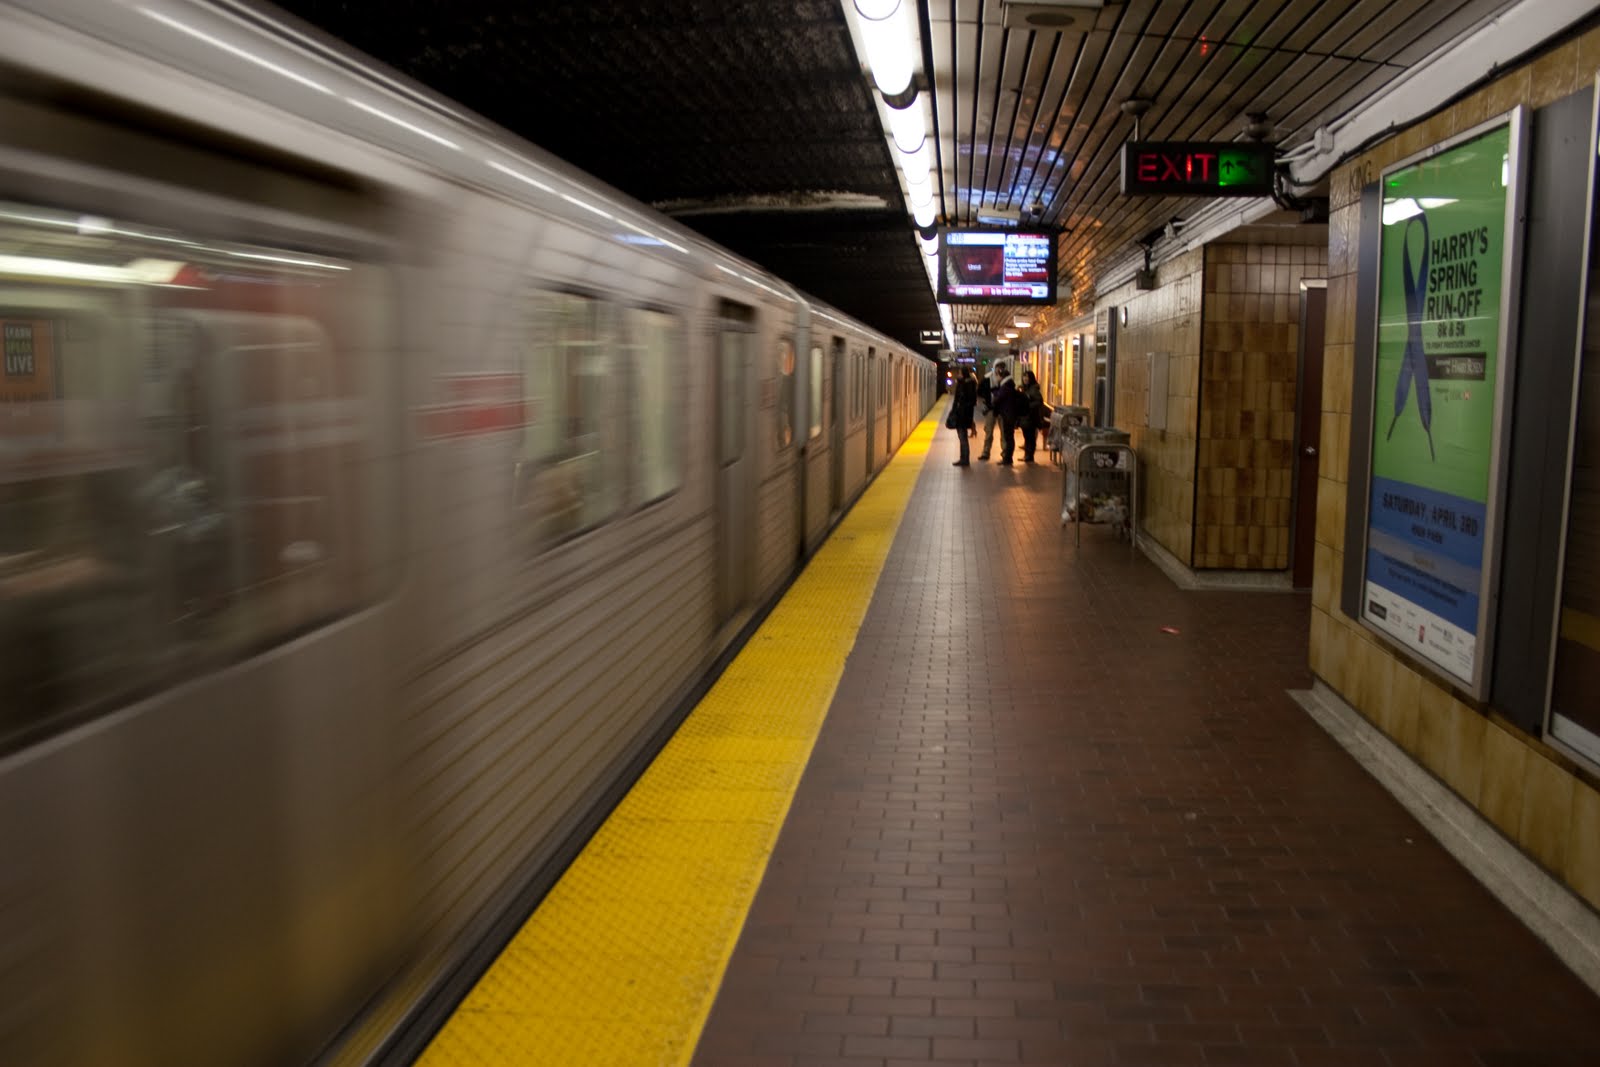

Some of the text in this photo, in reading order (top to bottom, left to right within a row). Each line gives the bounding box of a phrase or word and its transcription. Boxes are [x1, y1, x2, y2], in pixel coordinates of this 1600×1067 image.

[1138, 154, 1216, 182] EXIT
[1431, 226, 1488, 265] HARRY'S
[1429, 259, 1478, 293] SPRING
[1427, 289, 1482, 320] RUN-OFF
[7, 355, 33, 373] LIVE
[1431, 505, 1457, 531] APRIL
